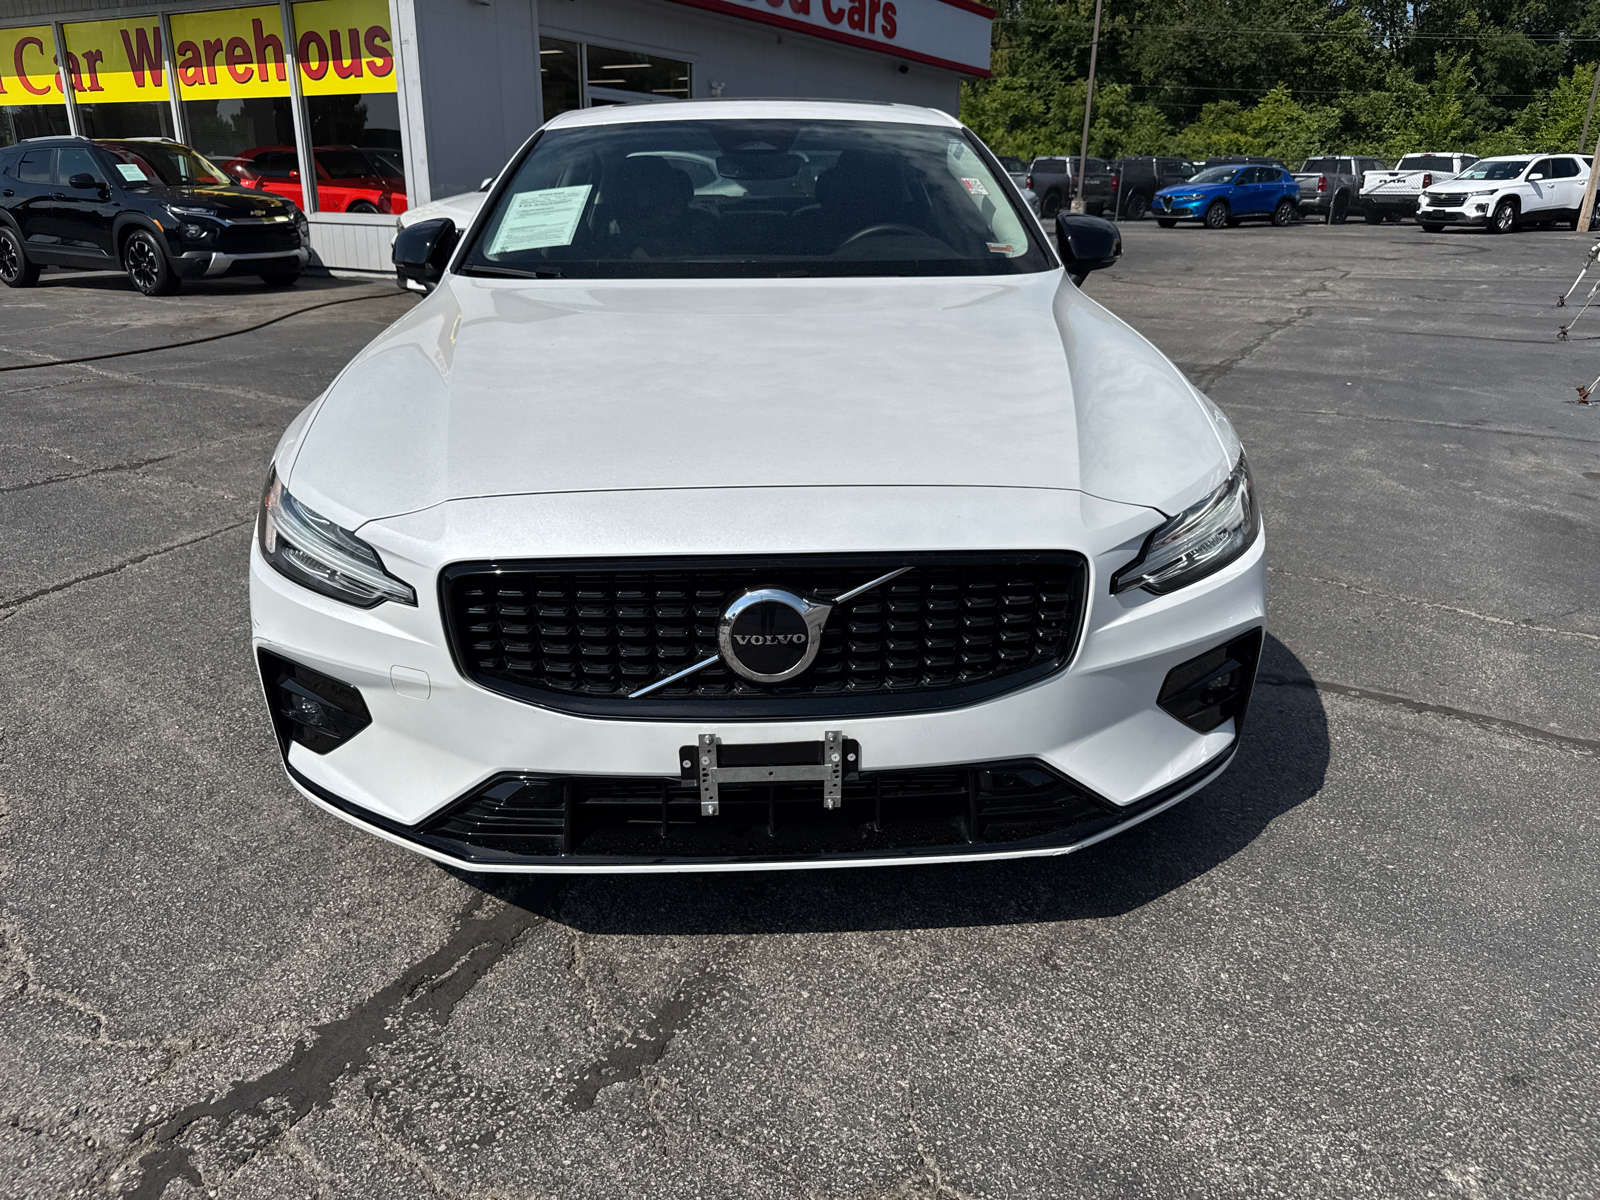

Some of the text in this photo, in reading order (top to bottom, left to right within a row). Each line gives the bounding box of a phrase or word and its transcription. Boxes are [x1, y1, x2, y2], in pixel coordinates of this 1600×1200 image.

[822, 0, 897, 39] Cars
[14, 37, 104, 95] Car
[733, 633, 807, 645] VOLVO
